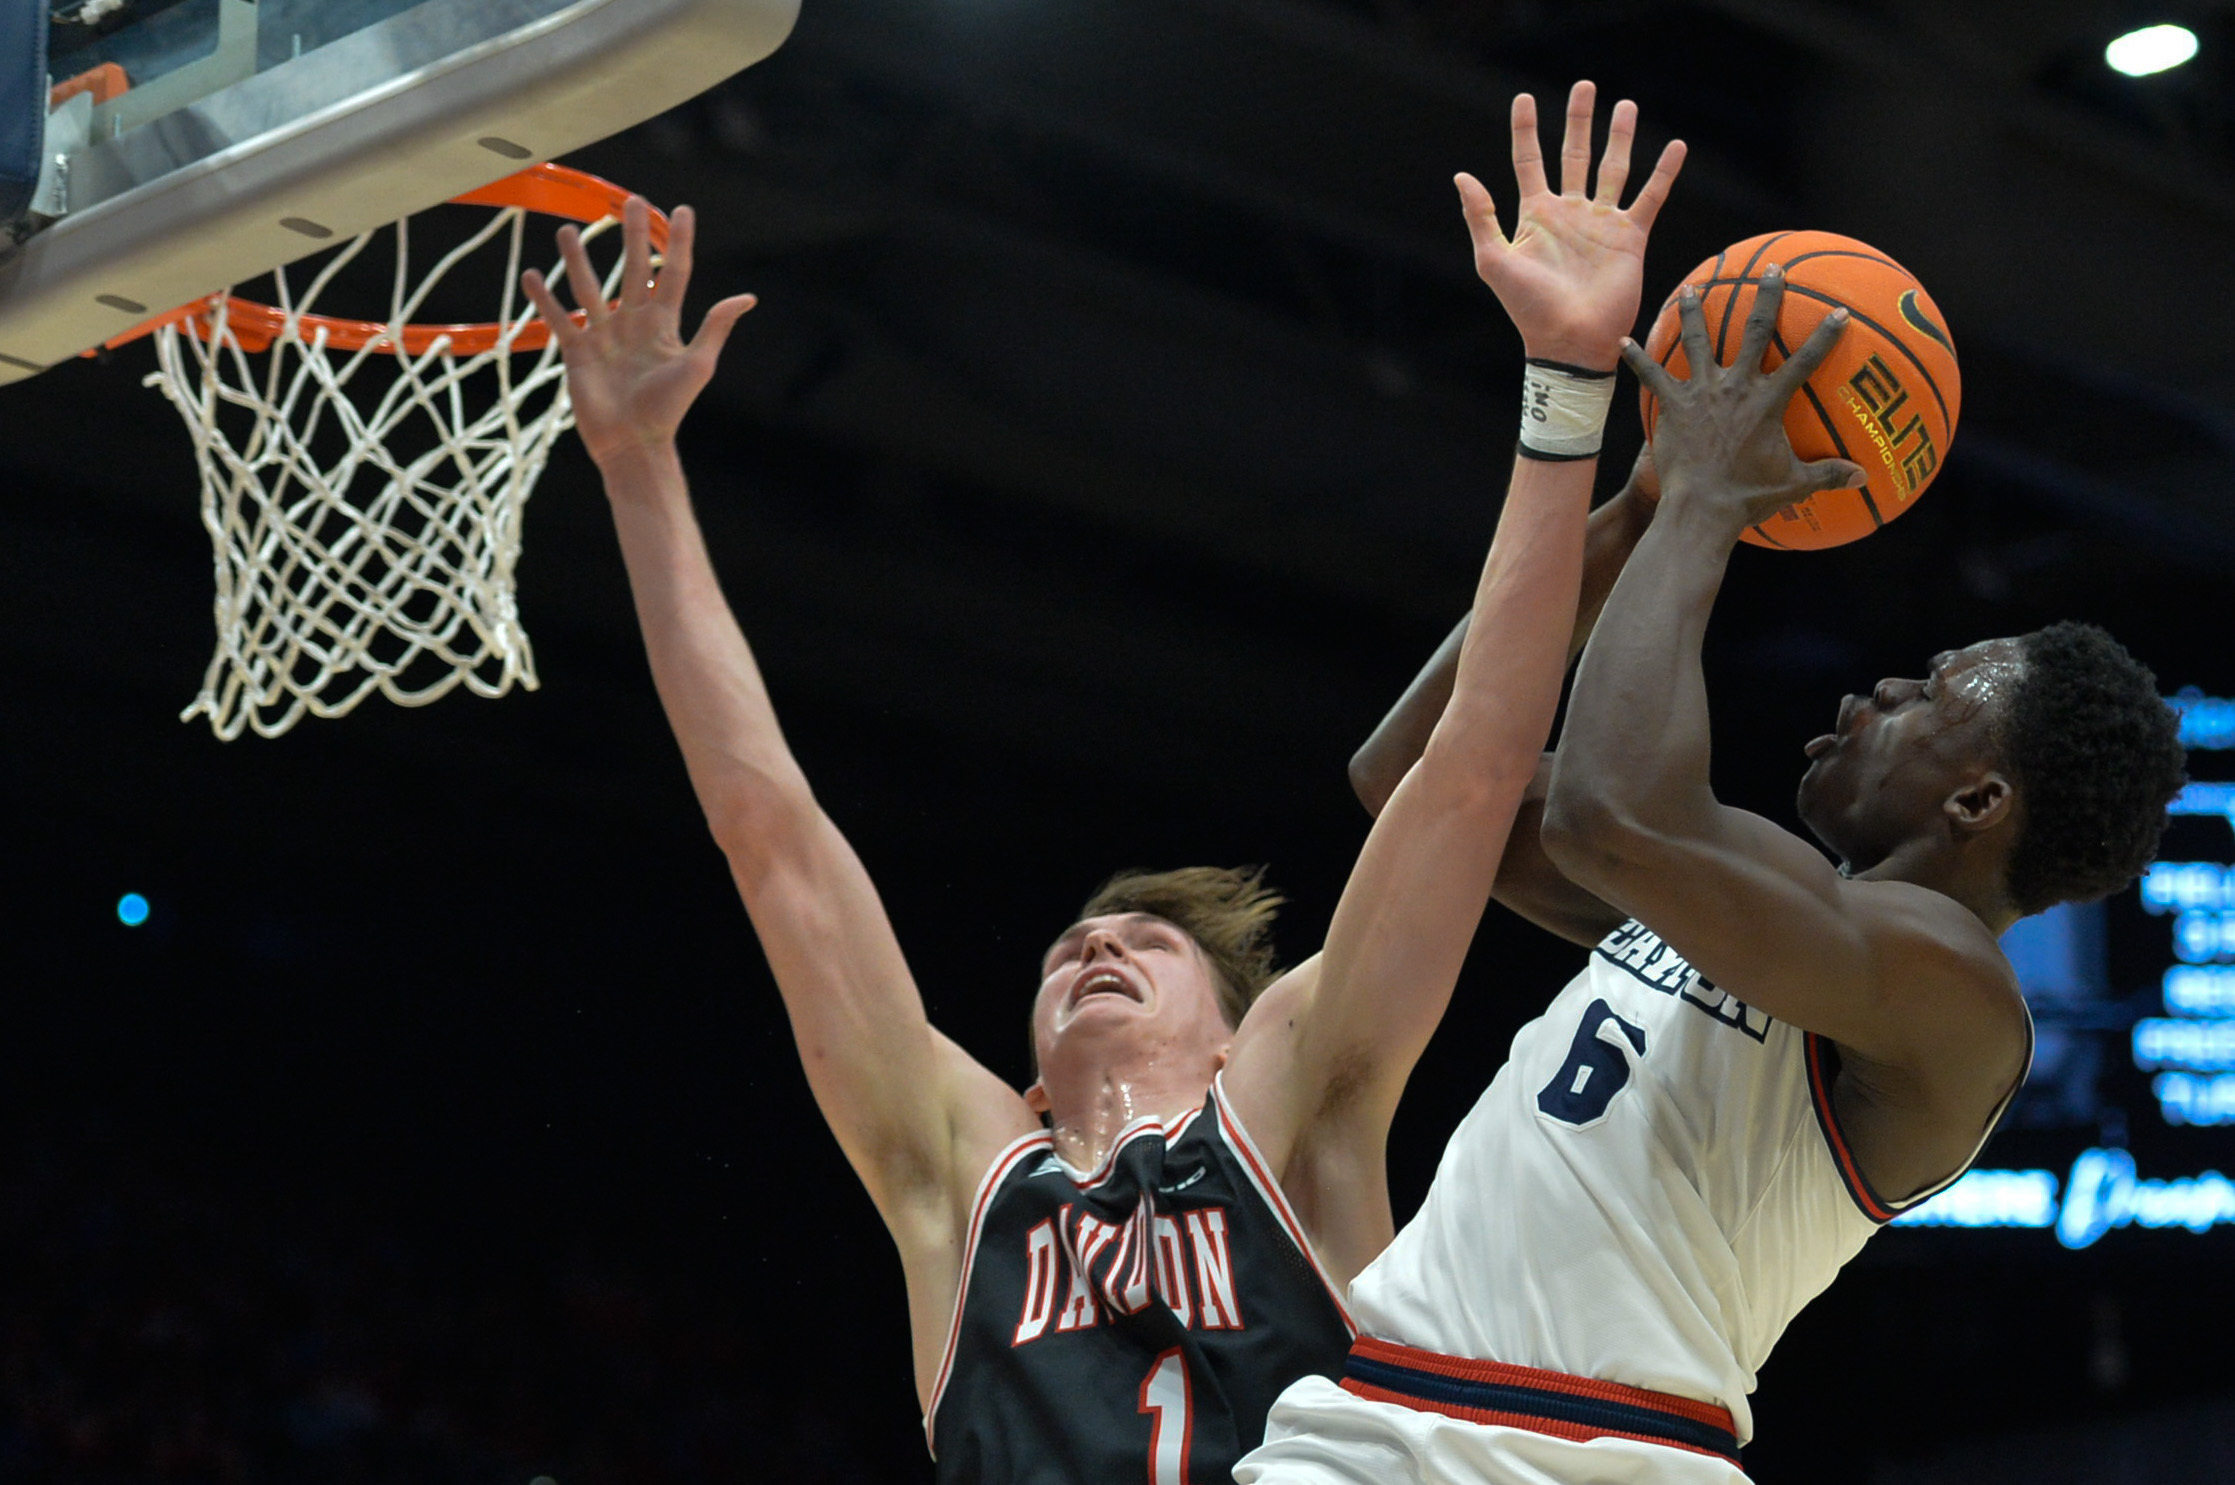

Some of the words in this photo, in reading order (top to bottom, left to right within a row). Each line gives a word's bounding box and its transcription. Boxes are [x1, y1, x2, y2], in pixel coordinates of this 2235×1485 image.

[1849, 352, 1937, 495] ELITE
[1536, 997, 1648, 1127] 6
[1138, 1345, 1194, 1485] 1
